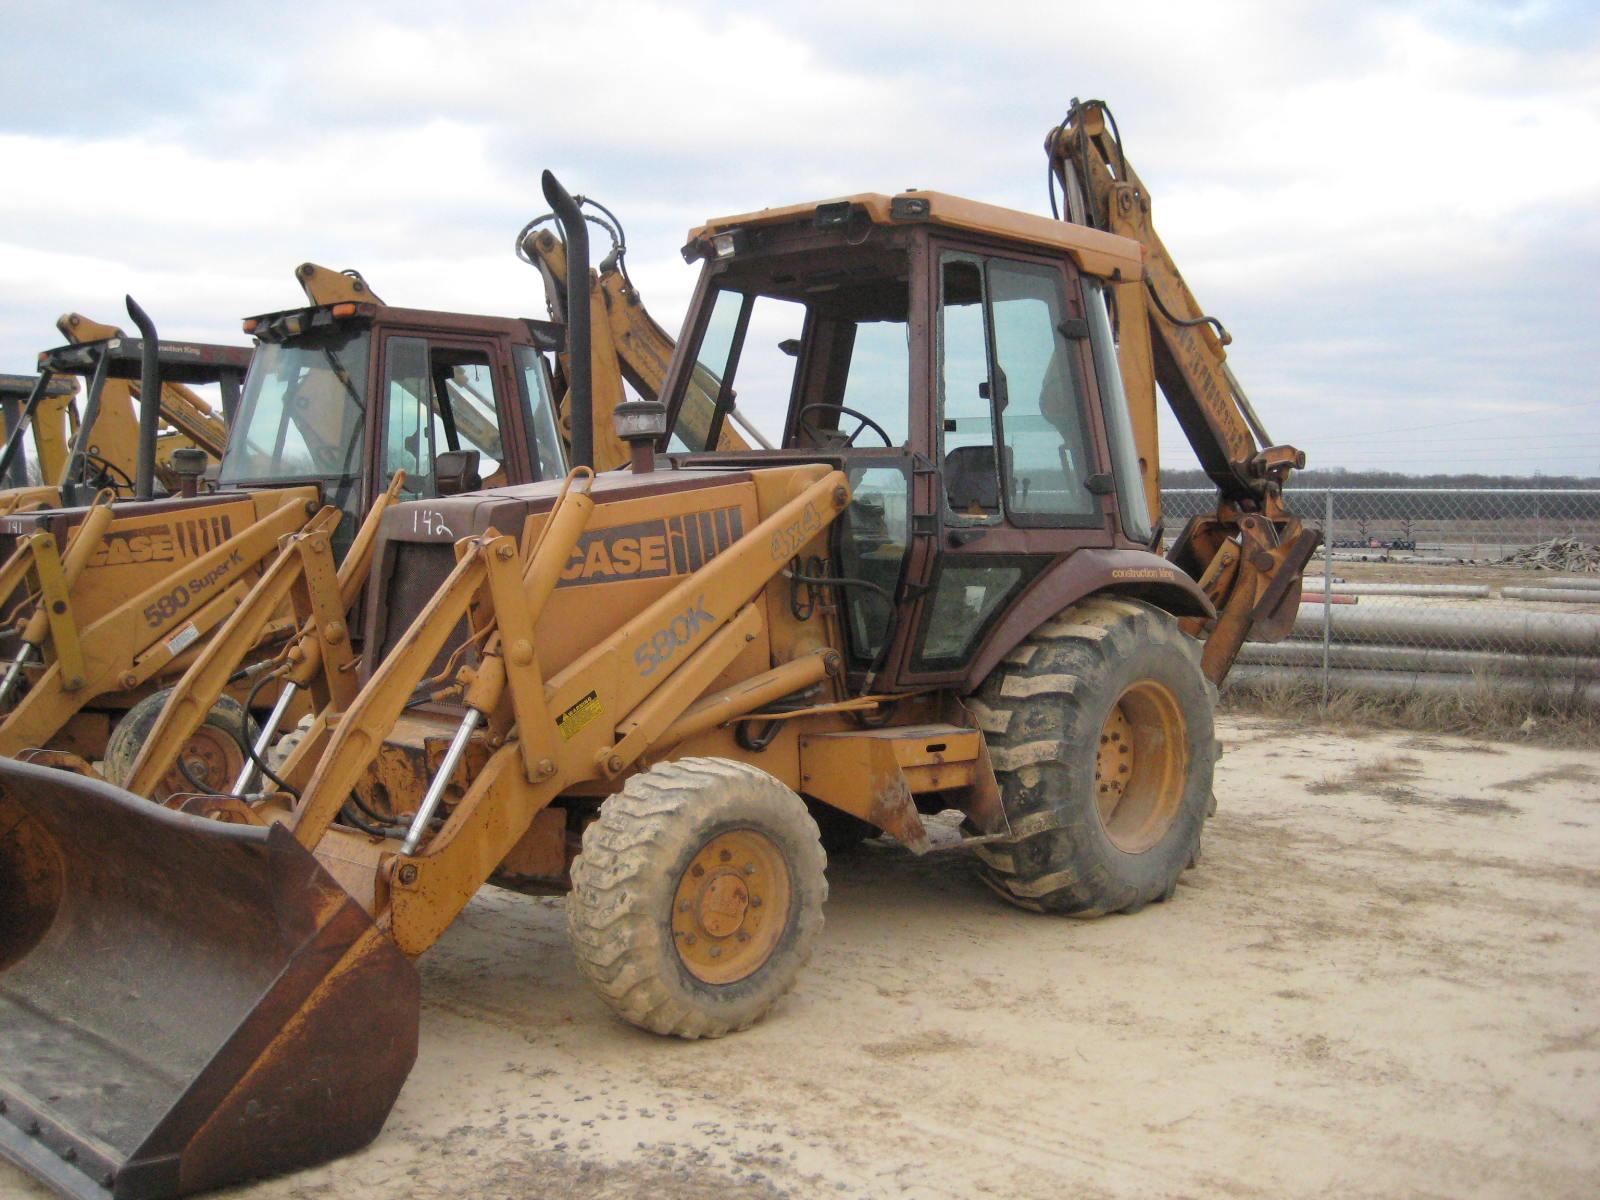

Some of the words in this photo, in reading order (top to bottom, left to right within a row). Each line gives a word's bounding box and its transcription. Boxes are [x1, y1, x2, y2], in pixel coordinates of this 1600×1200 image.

[8, 519, 22, 534] 141
[413, 509, 454, 537] 142
[144, 586, 190, 628] 580
[189, 563, 231, 594] Super
[632, 594, 717, 678] 580K
